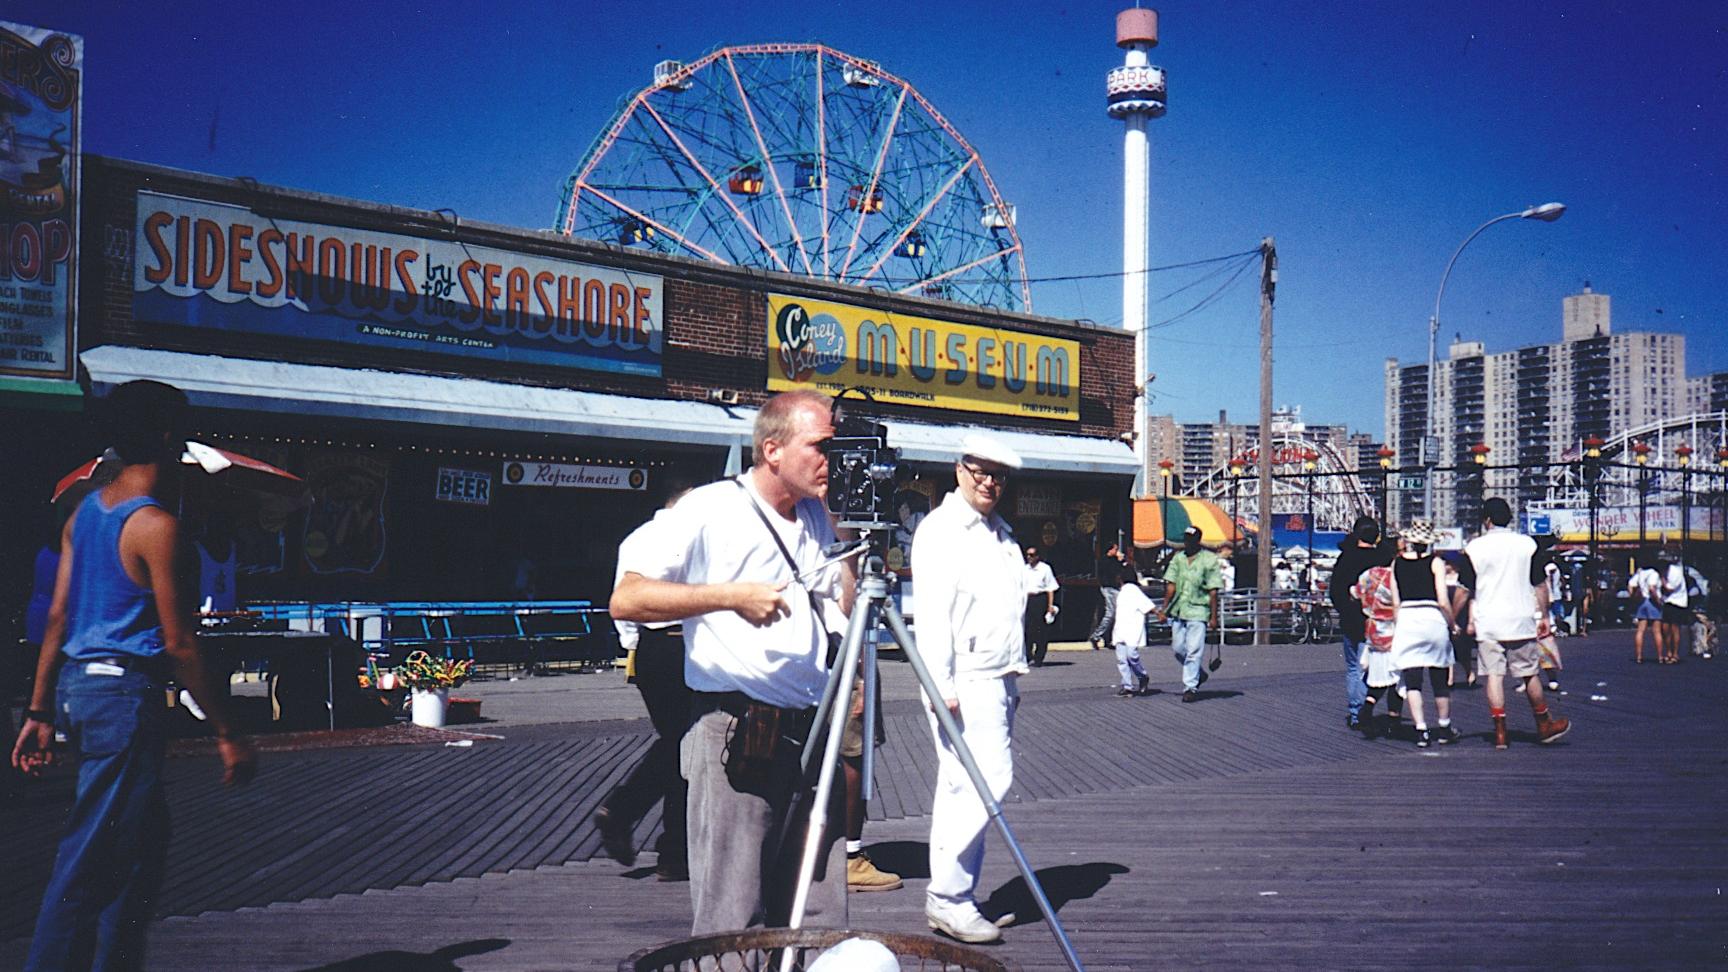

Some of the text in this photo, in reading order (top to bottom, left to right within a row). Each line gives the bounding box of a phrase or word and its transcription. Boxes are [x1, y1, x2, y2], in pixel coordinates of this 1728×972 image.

[143, 211, 420, 315] SIDESHOWS
[426, 253, 456, 297] by
[456, 259, 653, 344] SEASHORE
[362, 325, 370, 333] A
[372, 327, 430, 341] NON-PROFIT
[435, 335, 459, 345] ARTS
[785, 307, 837, 349] Coney
[781, 341, 849, 380] Island
[889, 388, 935, 401] BOARDWALK
[439, 475, 488, 499] BEER
[533, 464, 620, 487] Refreshments
[1652, 520, 1677, 529] PARK
